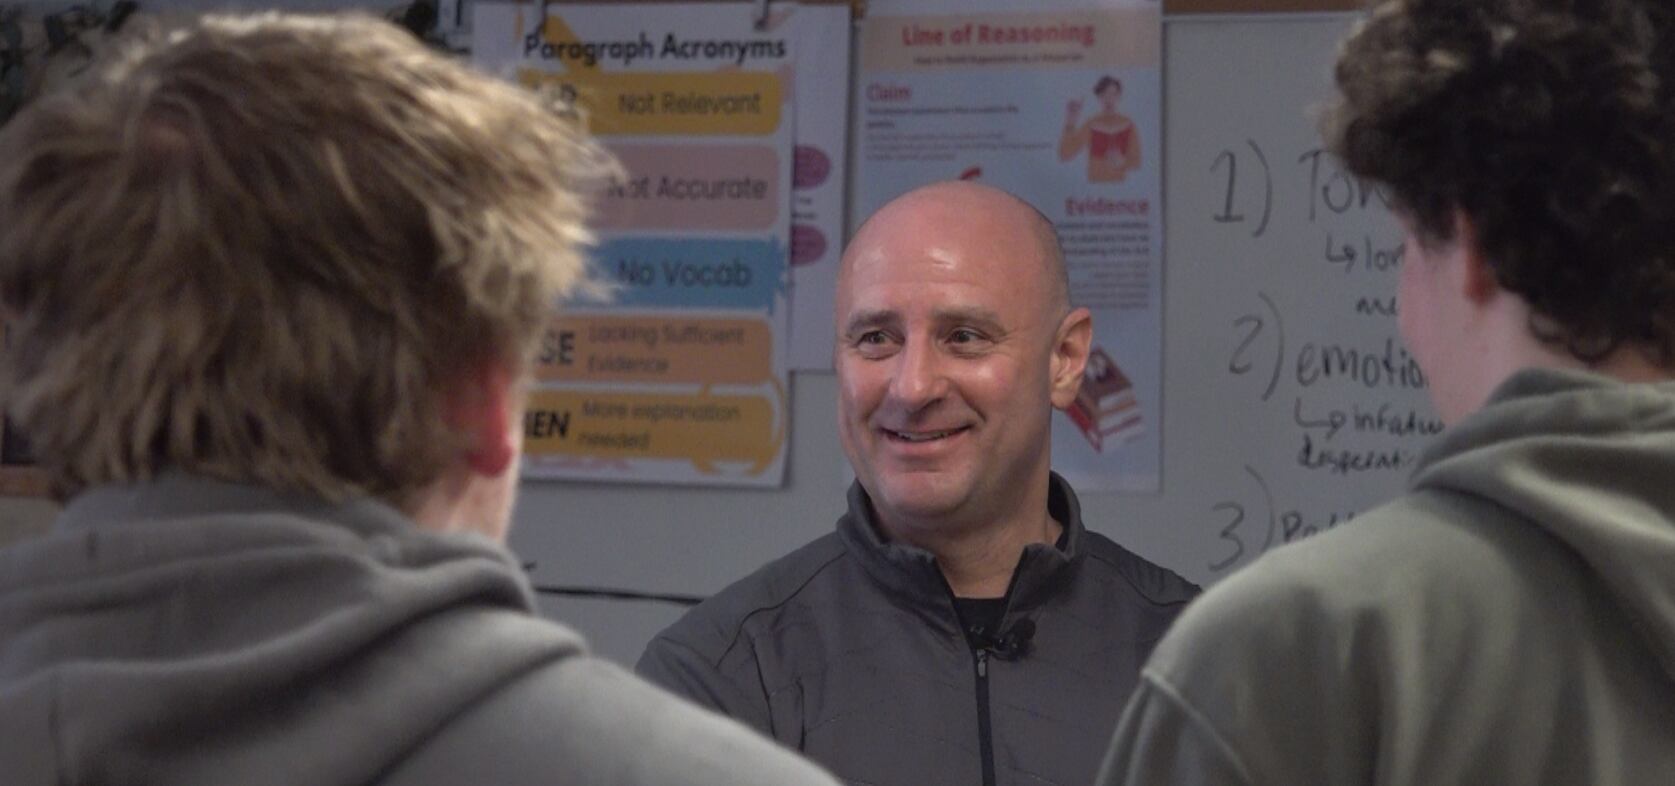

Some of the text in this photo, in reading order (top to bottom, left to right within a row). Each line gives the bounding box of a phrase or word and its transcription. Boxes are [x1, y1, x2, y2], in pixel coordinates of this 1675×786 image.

[902, 22, 1097, 48] Line of Reasoning
[523, 32, 787, 66] Paragraph Acronyms
[619, 93, 762, 115] Not Relevant
[866, 83, 912, 102] Claim
[607, 174, 769, 201] Not Accurate
[1209, 138, 1273, 238] 1)
[1064, 197, 1149, 216] Evidence
[619, 257, 752, 288] No Vocab
[539, 328, 577, 366] SE
[588, 322, 745, 349] Lacking Sufficient
[1229, 291, 1429, 402] 2) emotio
[588, 354, 669, 373] Evidence
[581, 403, 740, 424] More explanation
